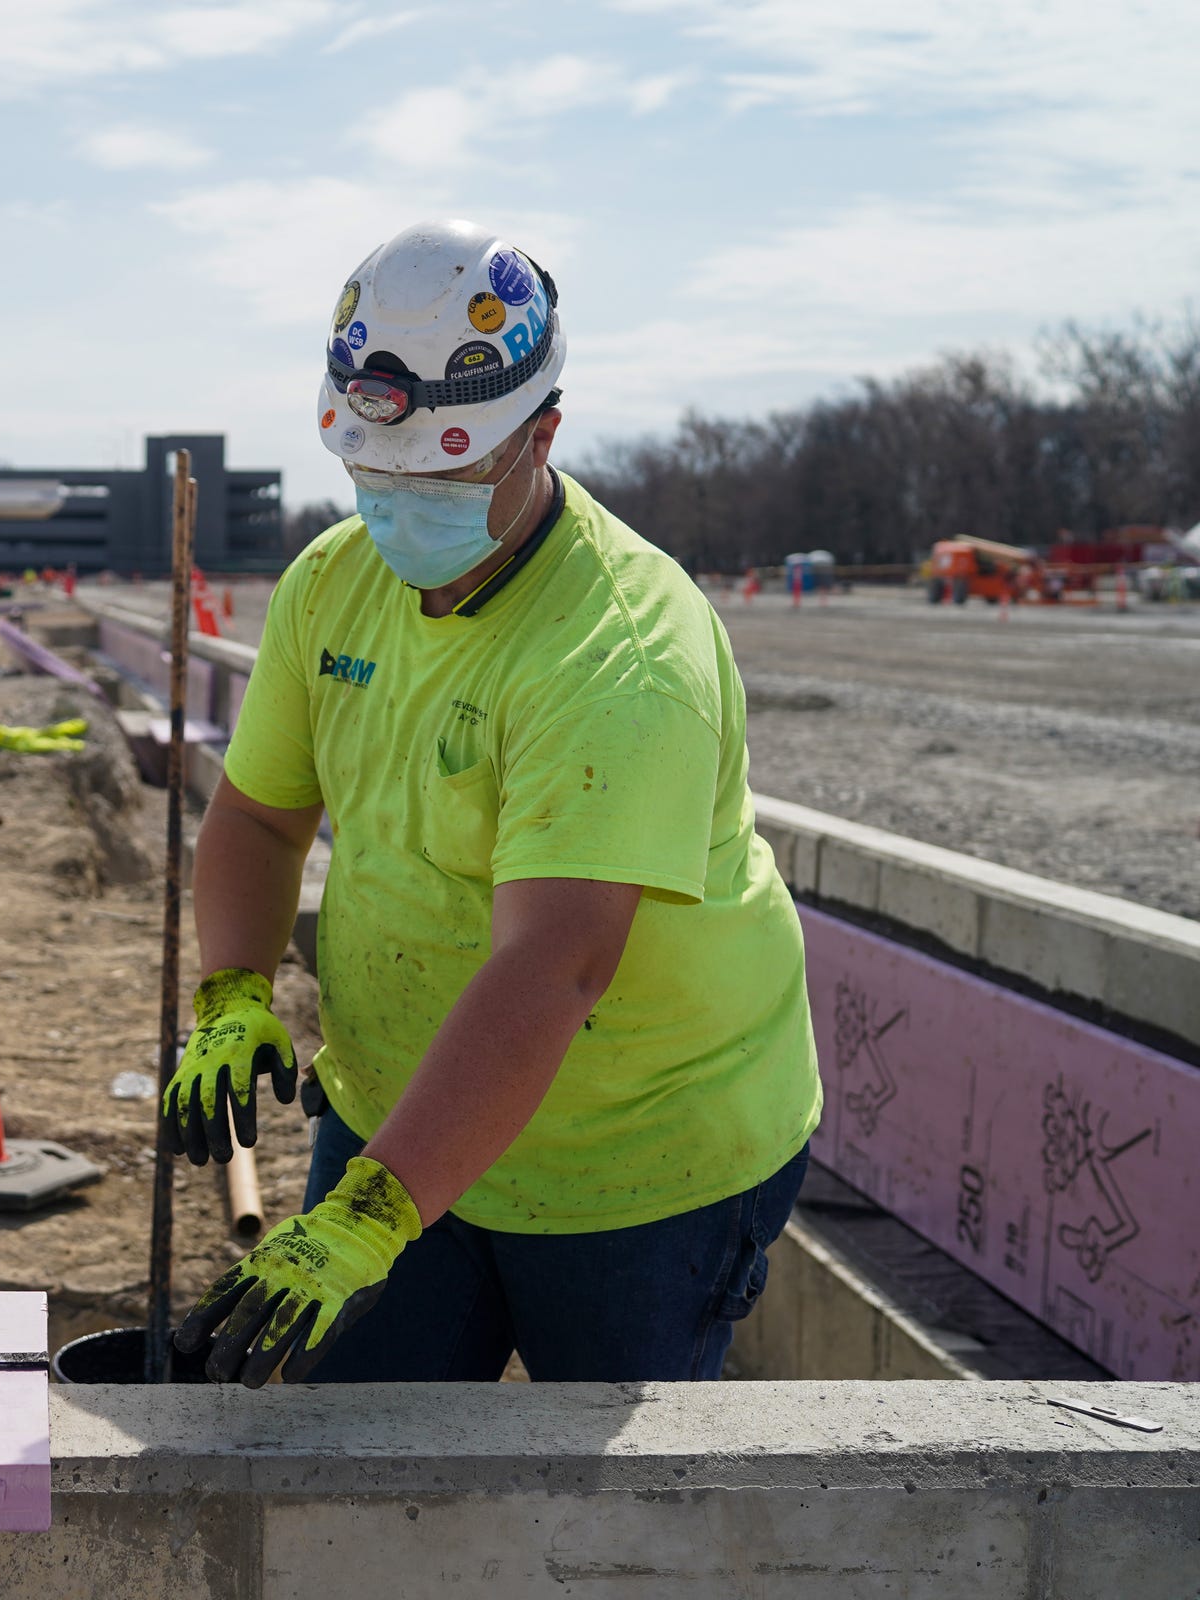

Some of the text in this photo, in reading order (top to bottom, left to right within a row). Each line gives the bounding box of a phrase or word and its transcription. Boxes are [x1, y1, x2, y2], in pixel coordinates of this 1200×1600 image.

[481, 309, 497, 320] AKC1
[352, 327, 363, 337] DC
[349, 336, 364, 347] WSB
[484, 361, 500, 372] MACK
[332, 654, 377, 685] RAM
[958, 1165, 984, 1253] 250
[269, 1235, 329, 1270] HAWWK6
[298, 1238, 323, 1258] KNIFE
